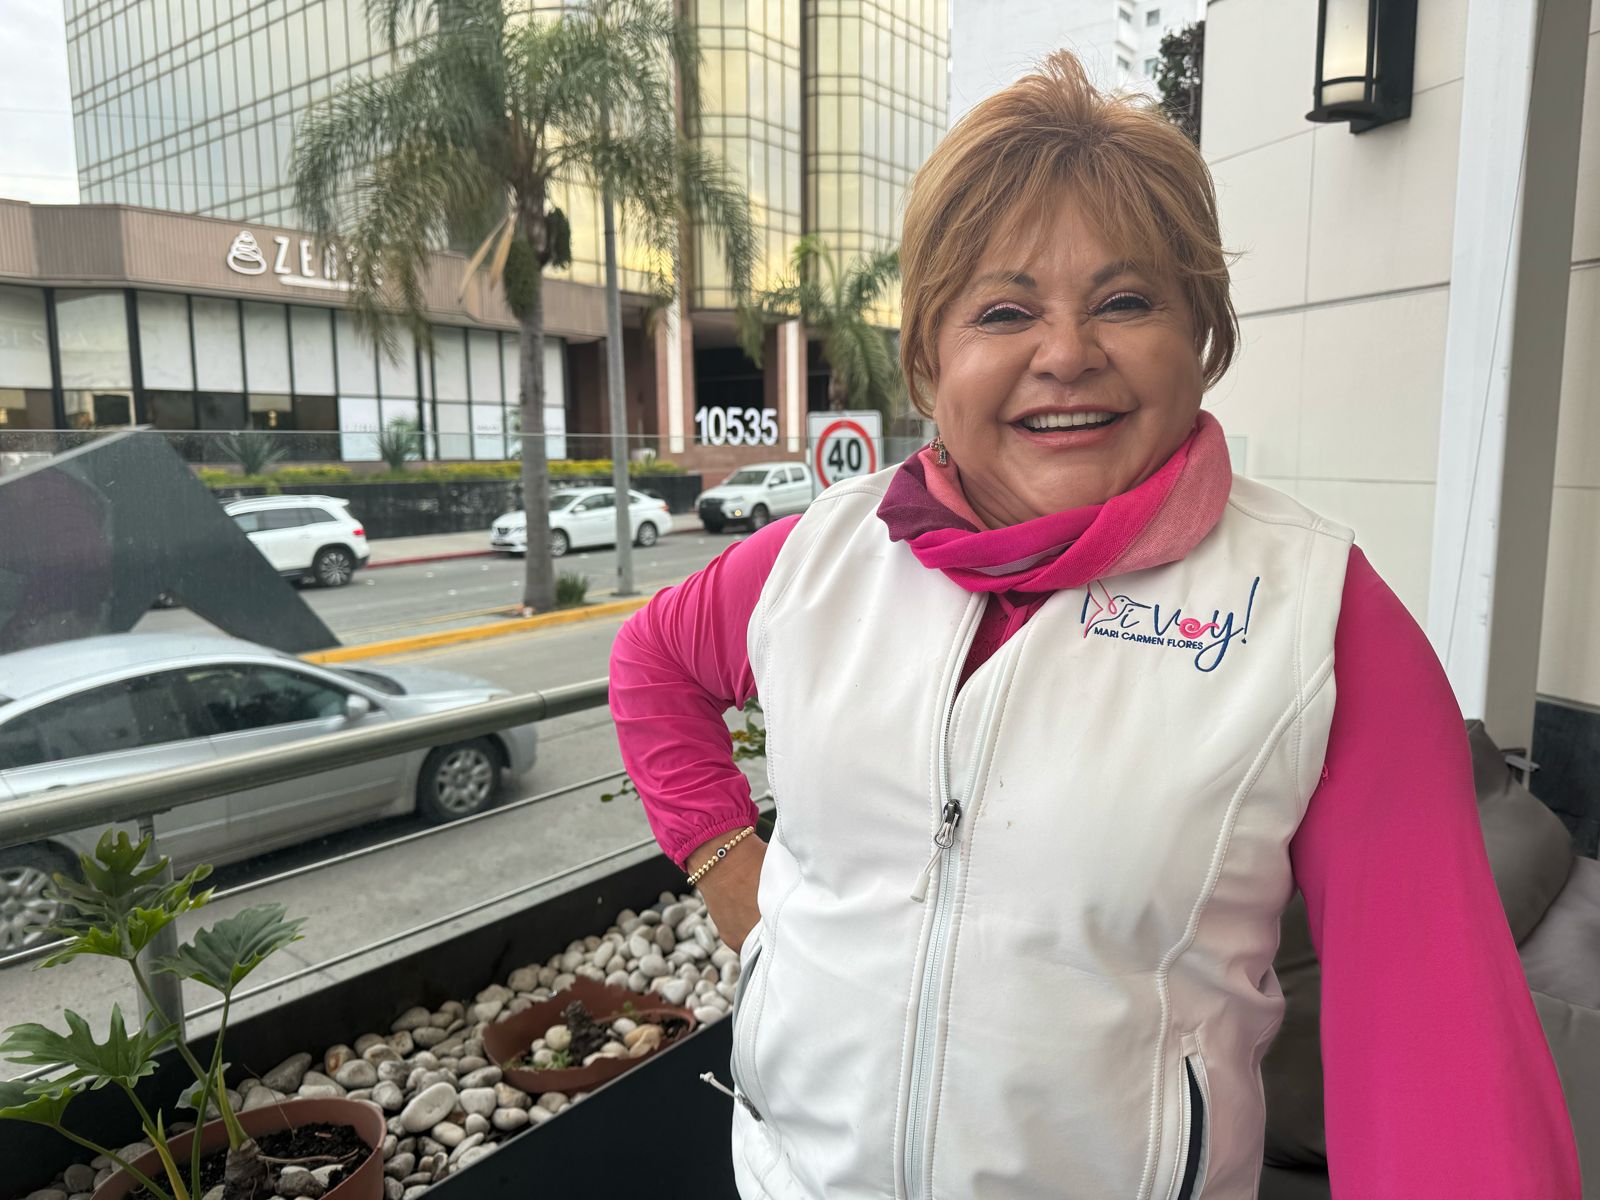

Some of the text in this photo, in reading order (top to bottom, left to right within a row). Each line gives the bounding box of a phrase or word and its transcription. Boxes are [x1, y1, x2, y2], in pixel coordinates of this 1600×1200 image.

[695, 406, 779, 447] 10535
[828, 439, 863, 473] 40
[1093, 626, 1204, 651] MARI CARMEN FLORES
